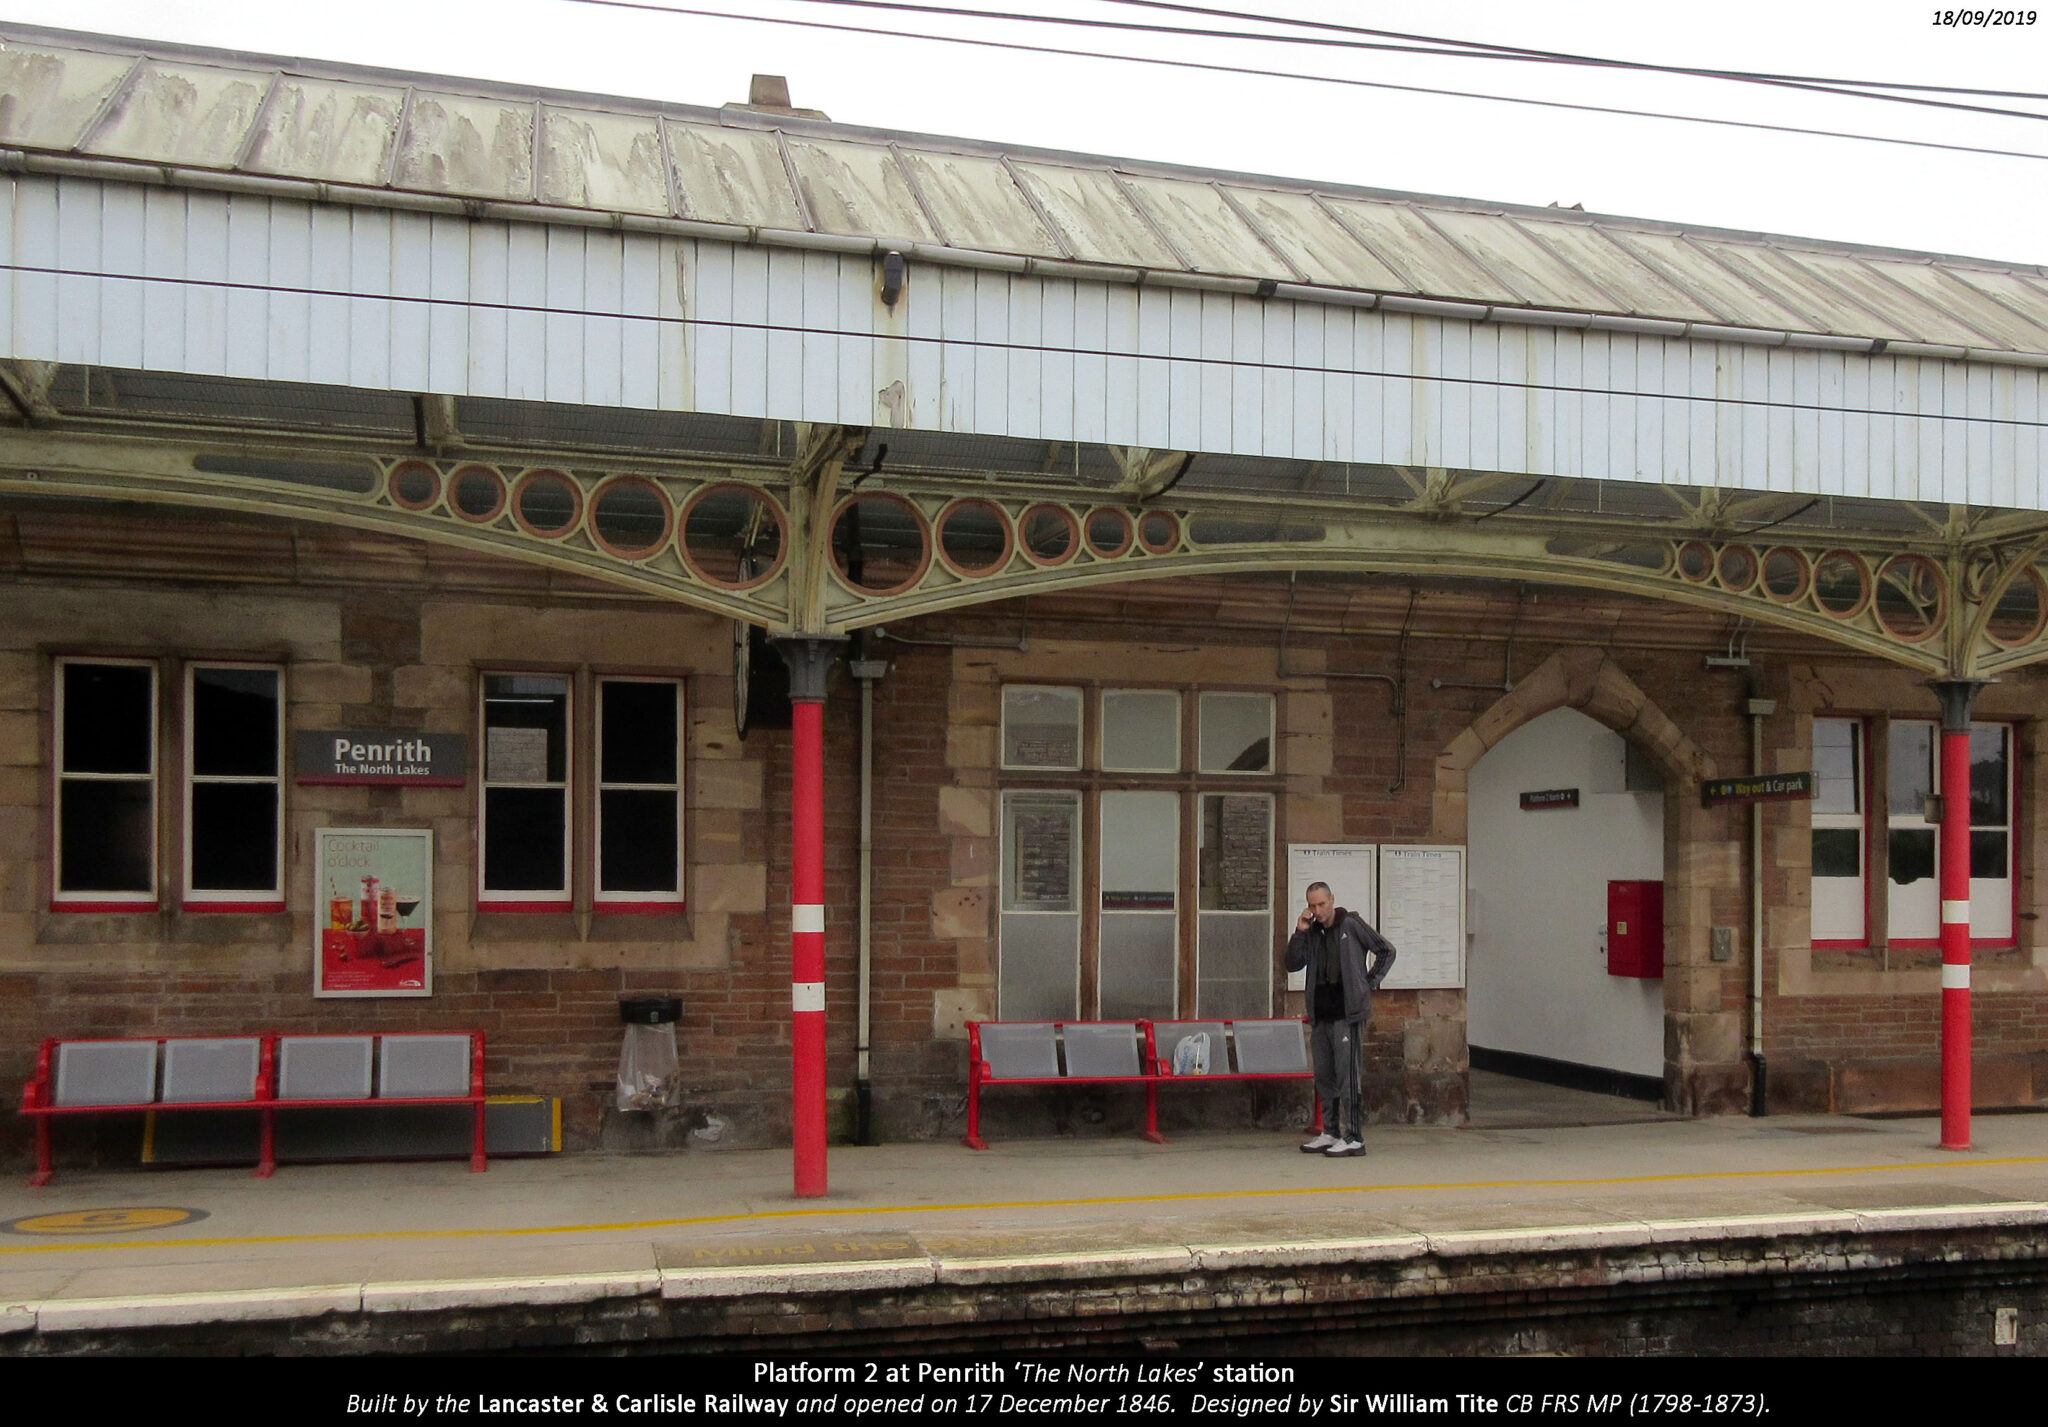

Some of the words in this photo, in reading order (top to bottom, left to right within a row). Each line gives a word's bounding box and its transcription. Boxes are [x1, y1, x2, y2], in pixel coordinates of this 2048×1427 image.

[335, 739, 431, 762] Penrith
[335, 763, 357, 774] The
[360, 764, 394, 775] North
[397, 765, 430, 776] Lakes
[1735, 783, 1751, 797] Way
[1752, 782, 1765, 793] out
[1765, 780, 1772, 793] &
[1773, 779, 1786, 792] Car
[1786, 778, 1803, 794] park
[328, 839, 380, 853] Cocktail
[1312, 850, 1331, 858] Train
[1332, 850, 1353, 858] Times
[1422, 851, 1442, 859] Times
[327, 856, 371, 868] o'clock
[694, 1242, 816, 1258] Mind
